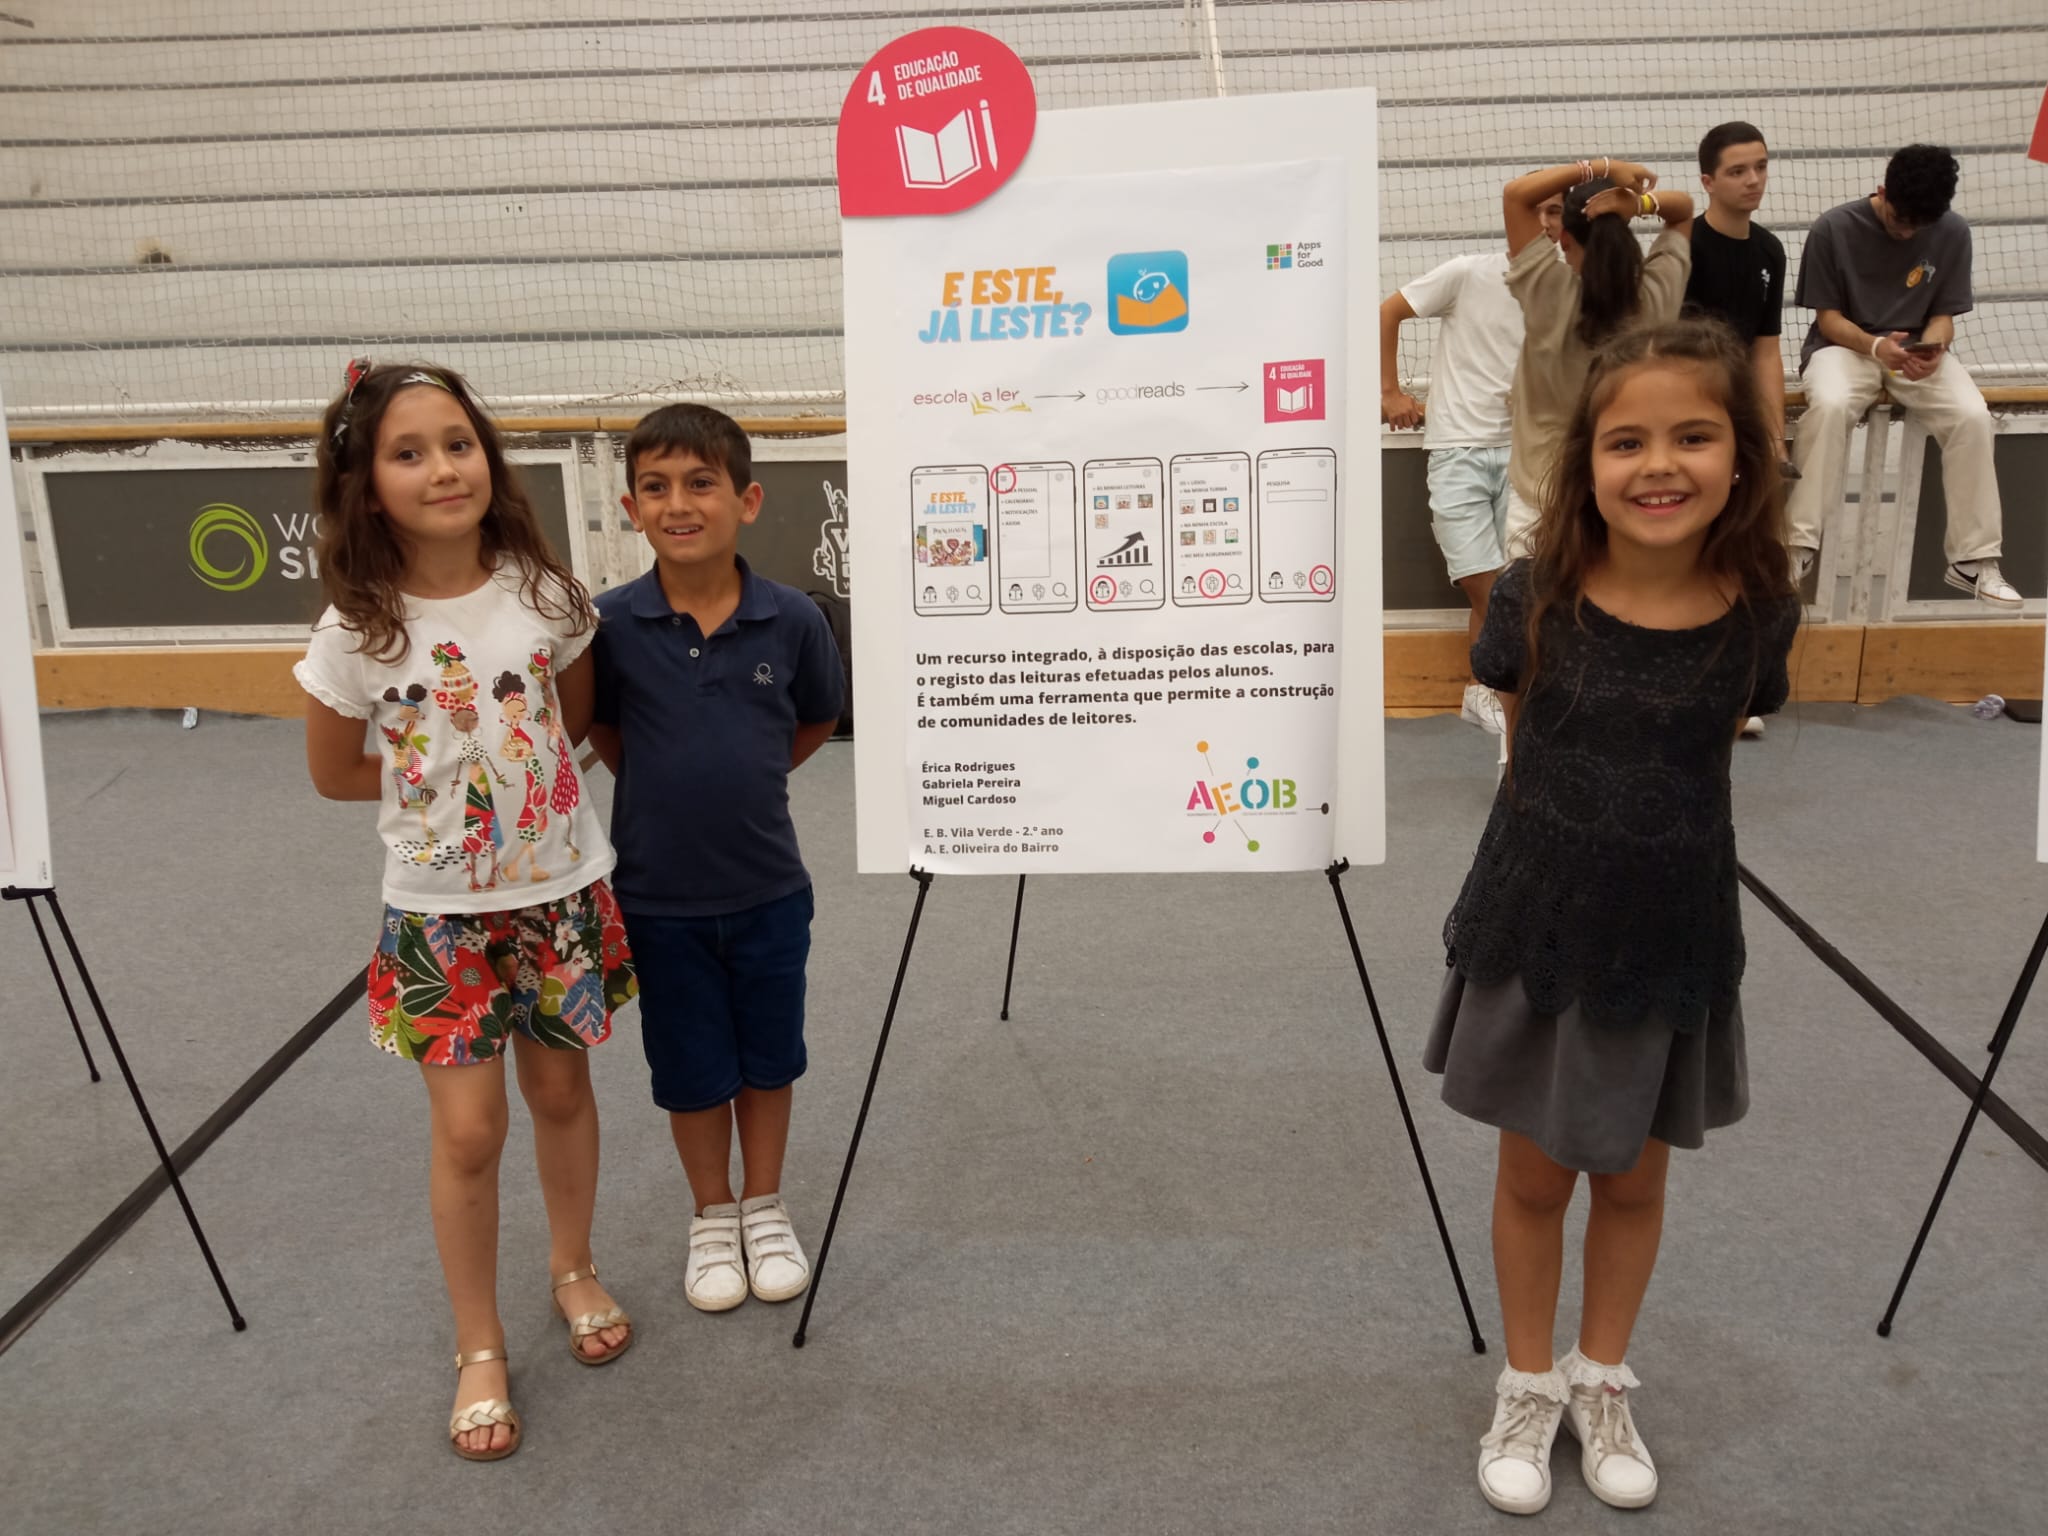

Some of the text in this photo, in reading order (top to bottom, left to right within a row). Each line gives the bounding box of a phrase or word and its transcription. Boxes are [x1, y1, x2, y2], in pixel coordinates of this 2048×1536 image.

[894, 50, 959, 81] EDUCAÇÃO
[867, 70, 886, 106] 4
[897, 64, 983, 100] DE QUALIDADE
[1297, 241, 1321, 251] Apps
[1297, 251, 1311, 259] for
[1297, 258, 1324, 268] Good
[942, 266, 1064, 307] E ESTE,
[918, 301, 1093, 344] JÁ LESTE?
[1268, 366, 1276, 380] 4
[913, 387, 1020, 405] escola a ler
[1096, 381, 1185, 405] goodreads
[915, 641, 1335, 666] Um recurso integrado, à disposição das escolas, para
[916, 663, 1274, 690] o registo das leituras efetuadas pelos alunos.
[916, 683, 1335, 708] É também uma ferramenta que permite a construção
[917, 711, 1137, 729] de comunidades de leitores.
[921, 760, 1016, 775] Érica Rodrigues
[921, 777, 1021, 790] Gabriela Pereira
[922, 793, 1017, 809] Miguel Cardoso
[1186, 778, 1297, 816] AEOB
[923, 828, 934, 839] E.
[936, 828, 948, 838] B.
[950, 826, 975, 838] Vila
[976, 826, 1013, 838] Verde
[1022, 826, 1038, 837] 2.º
[1040, 827, 1064, 836] ano
[924, 842, 1060, 855] A. E. Oliveira do Bairro
